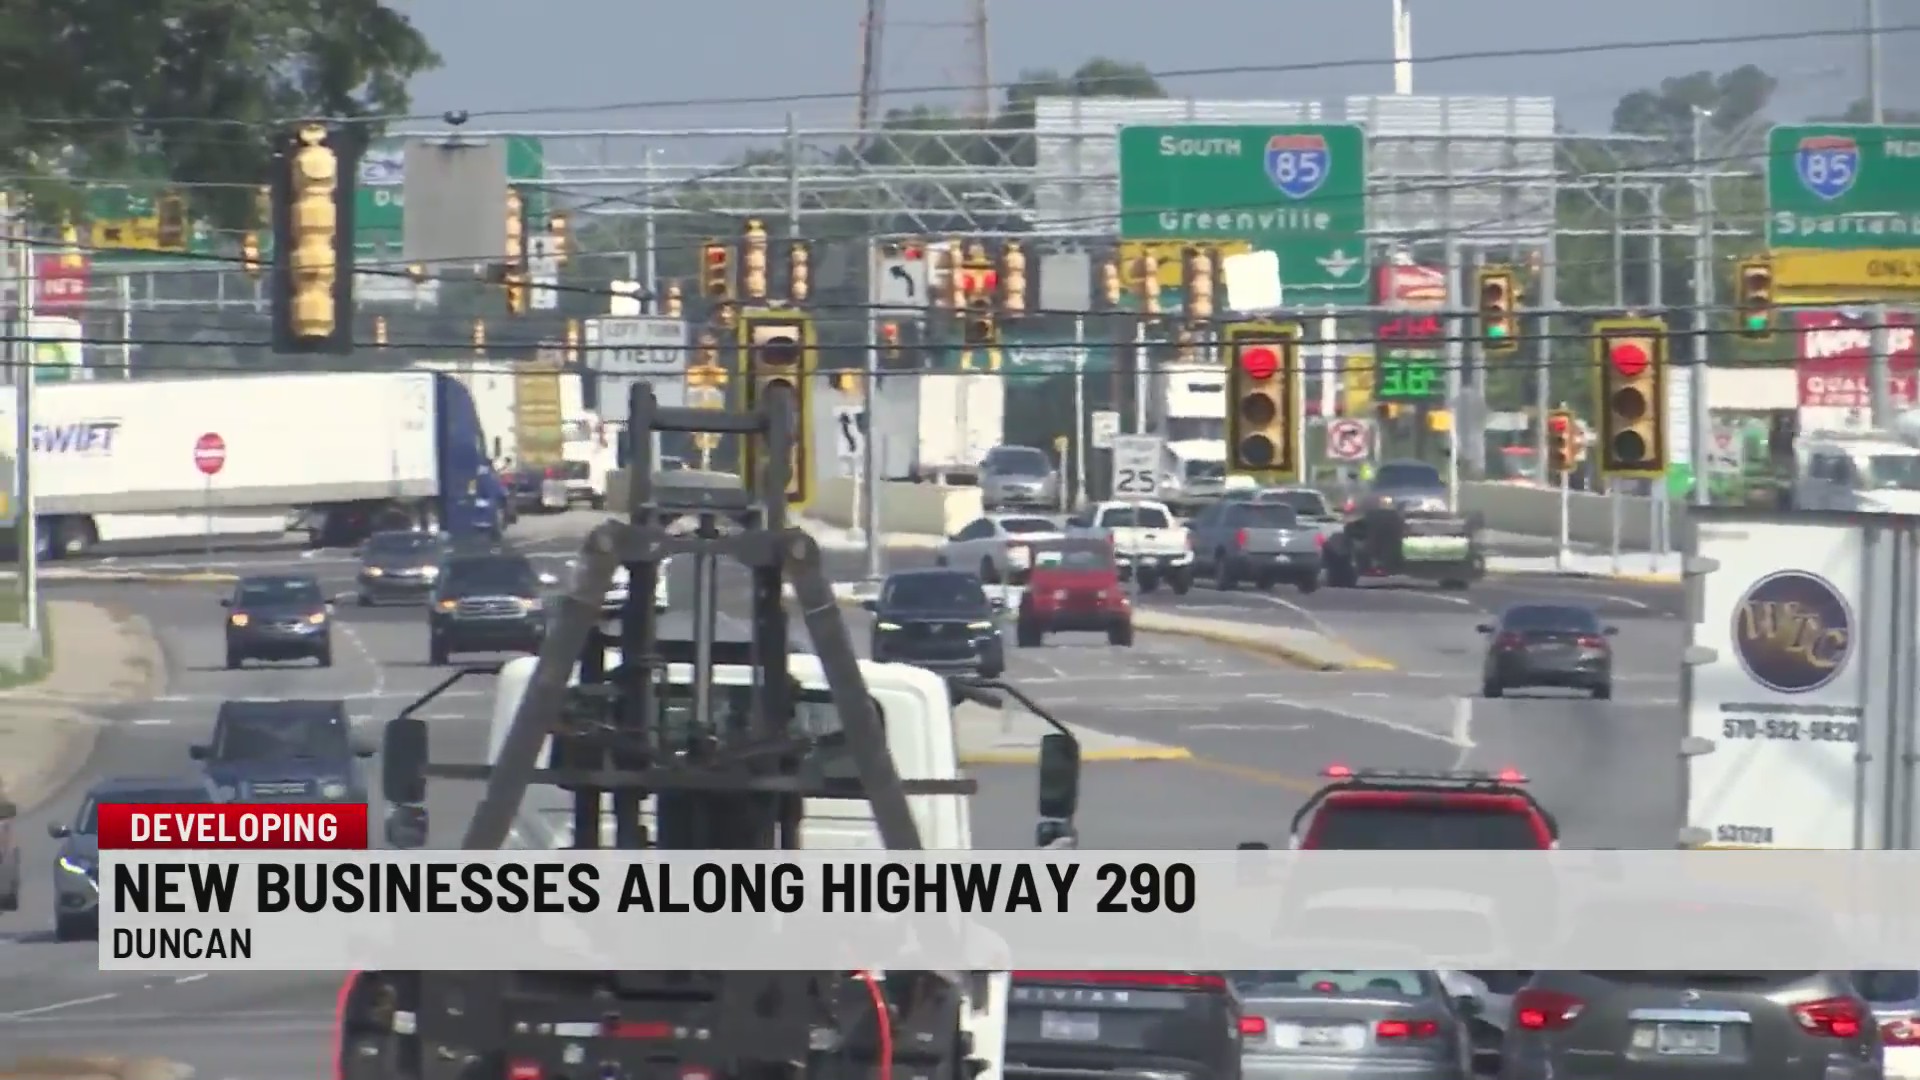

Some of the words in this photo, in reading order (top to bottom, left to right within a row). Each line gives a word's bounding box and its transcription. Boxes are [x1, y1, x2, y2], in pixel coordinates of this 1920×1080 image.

[1160, 135, 1242, 157] SOUTH
[1275, 152, 1321, 183] 85
[1807, 154, 1852, 186] 85
[1158, 208, 1332, 231] Greenville
[1118, 469, 1155, 492] 25
